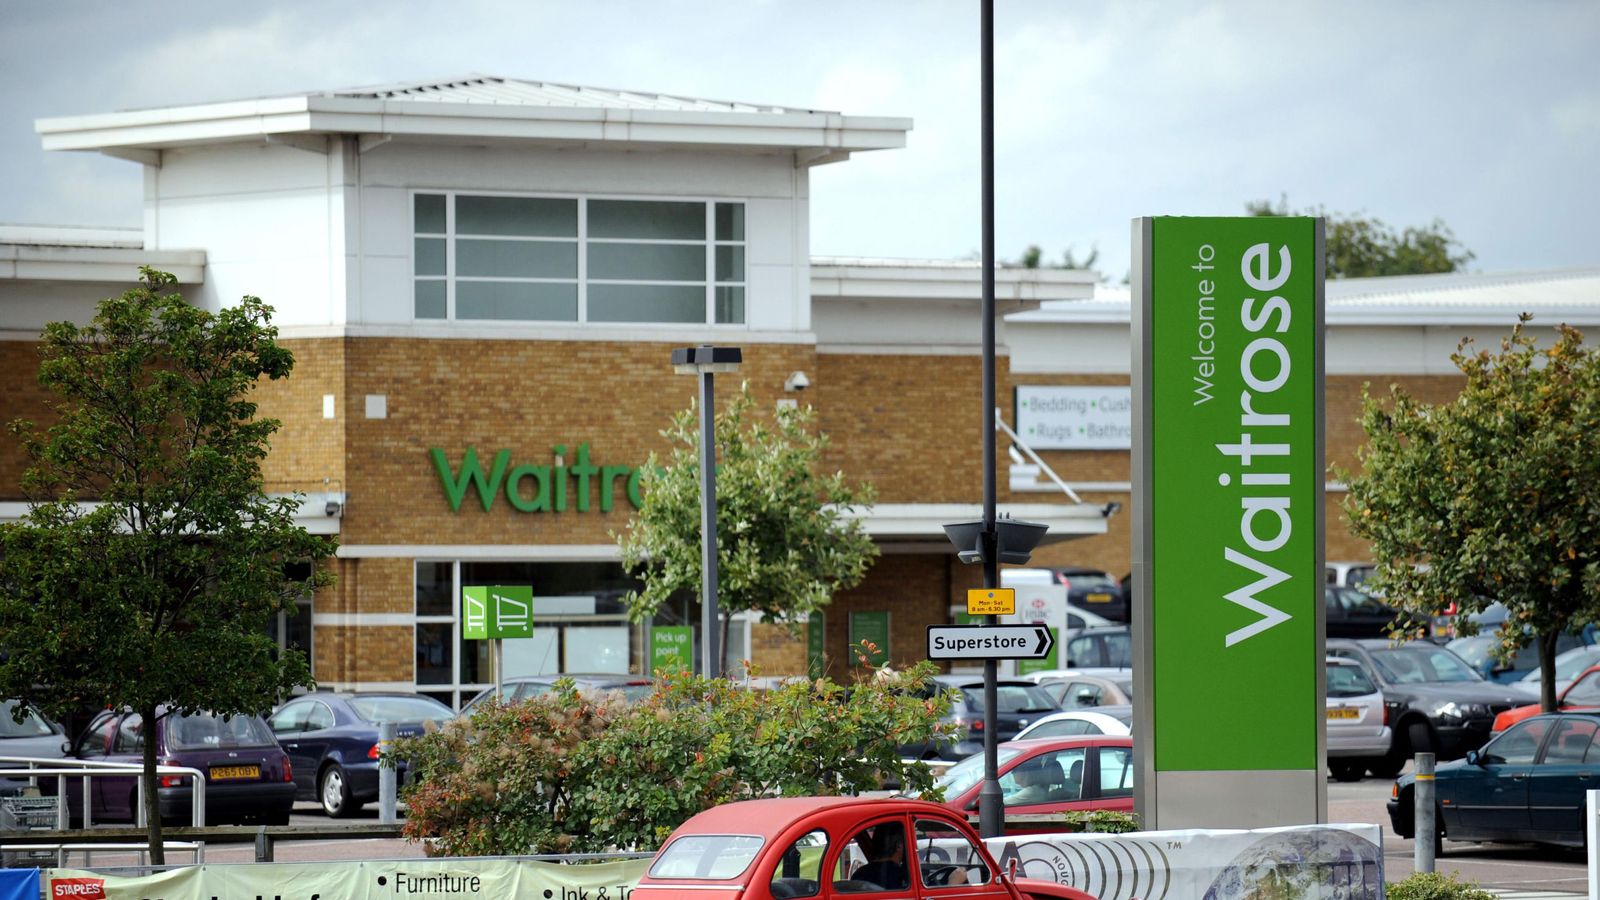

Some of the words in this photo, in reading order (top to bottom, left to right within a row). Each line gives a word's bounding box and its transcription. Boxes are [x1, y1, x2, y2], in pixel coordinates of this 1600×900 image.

[1191, 243, 1215, 272] to
[1191, 279, 1215, 406] Welcome
[1030, 396, 1087, 416] Bedding
[1037, 422, 1072, 442] Rugs
[1215, 242, 1293, 648] Waitrose
[430, 442, 664, 513] Waitr
[655, 631, 673, 642] Pick
[674, 633, 687, 645] up
[934, 635, 1027, 652] Superstore
[655, 645, 679, 659] point
[1166, 841, 1182, 850] TM
[55, 883, 101, 897] STAPLES
[395, 872, 481, 893] Furniture
[561, 886, 589, 900] Ink
